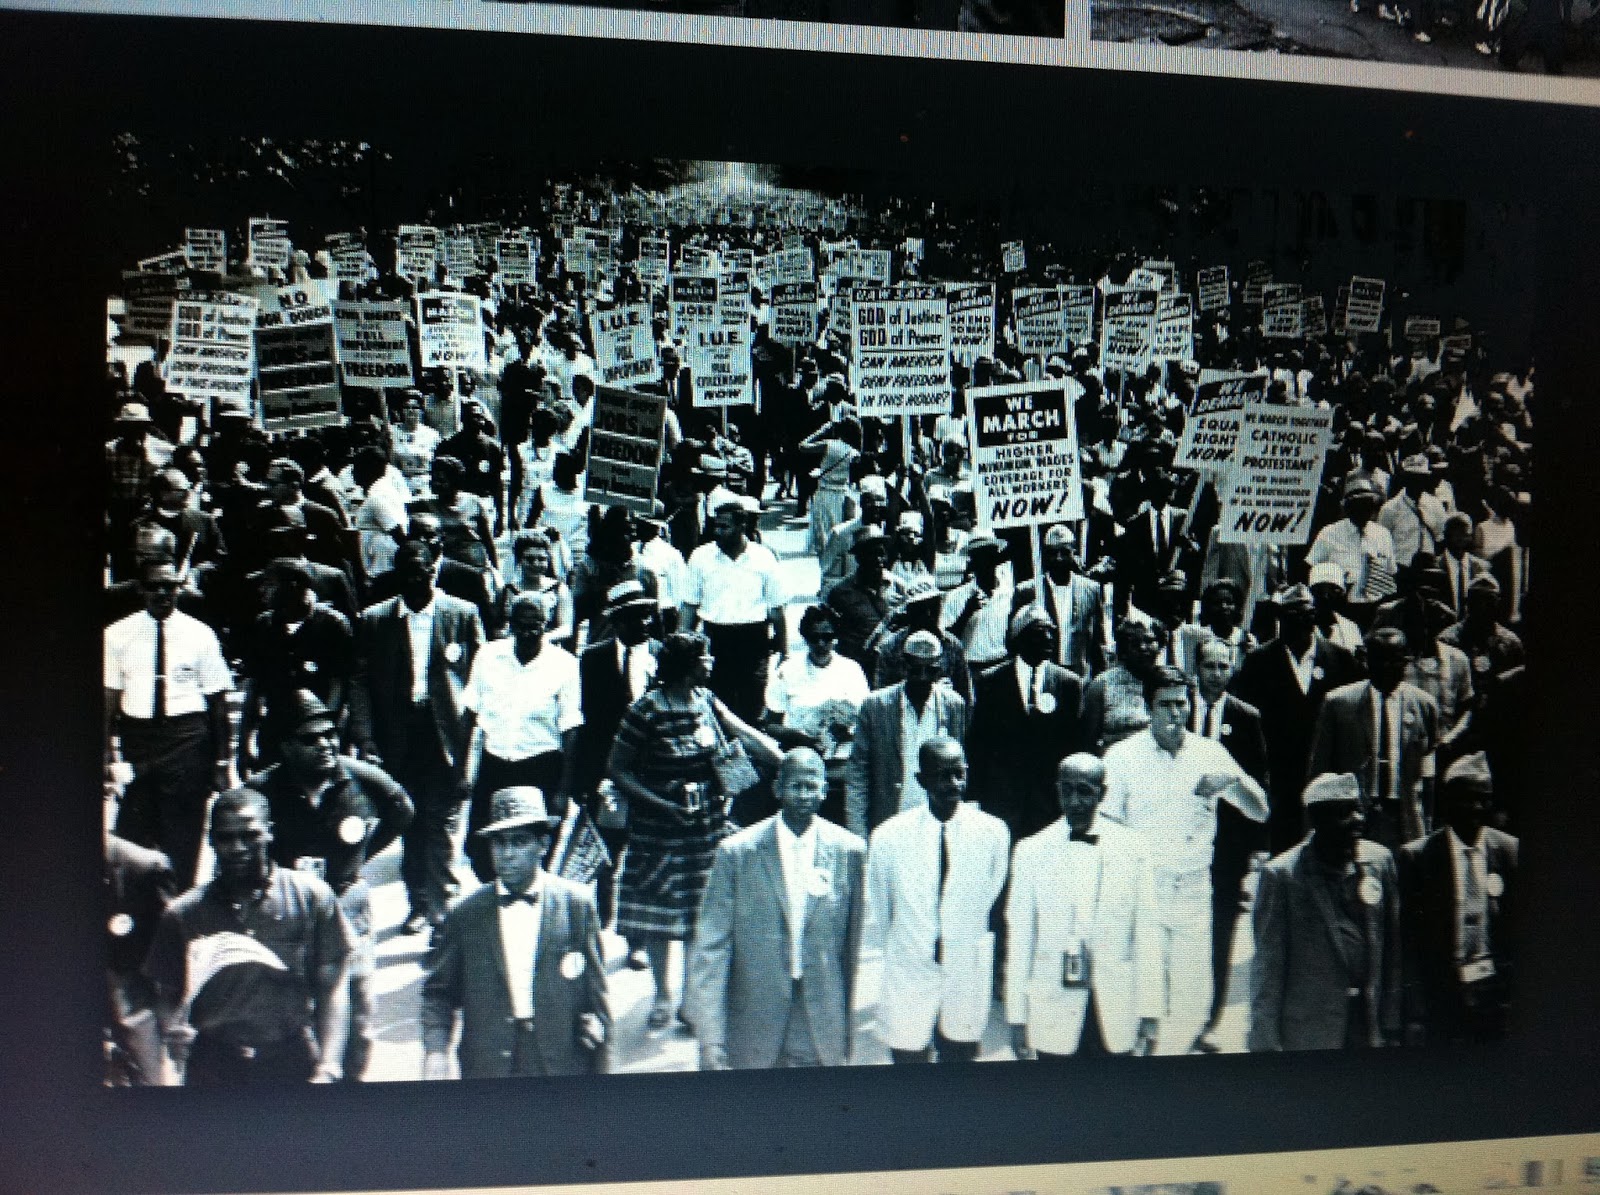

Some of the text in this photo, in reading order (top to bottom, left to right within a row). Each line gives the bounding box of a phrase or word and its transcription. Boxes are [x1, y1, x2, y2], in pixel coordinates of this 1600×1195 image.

[858, 307, 886, 326] GOD
[889, 307, 902, 326] of
[859, 328, 887, 346] GOD
[891, 328, 904, 346] of
[344, 362, 411, 377] FREEDOM
[1005, 395, 1033, 411] WE
[982, 408, 1061, 434] MARCH
[1196, 417, 1241, 432] EQUA
[1191, 433, 1238, 446] RIGHT
[1251, 429, 1318, 446] CATHOLIC
[995, 443, 1054, 460] HIGHER
[1260, 445, 1302, 458] JEWS
[977, 453, 1075, 475] MINIMUM WAGES
[983, 467, 1072, 487] COVERAGE FOR
[987, 479, 1069, 498] ALL WORKERS
[990, 491, 1069, 521] NOW!
[1234, 509, 1306, 534] NOW!
